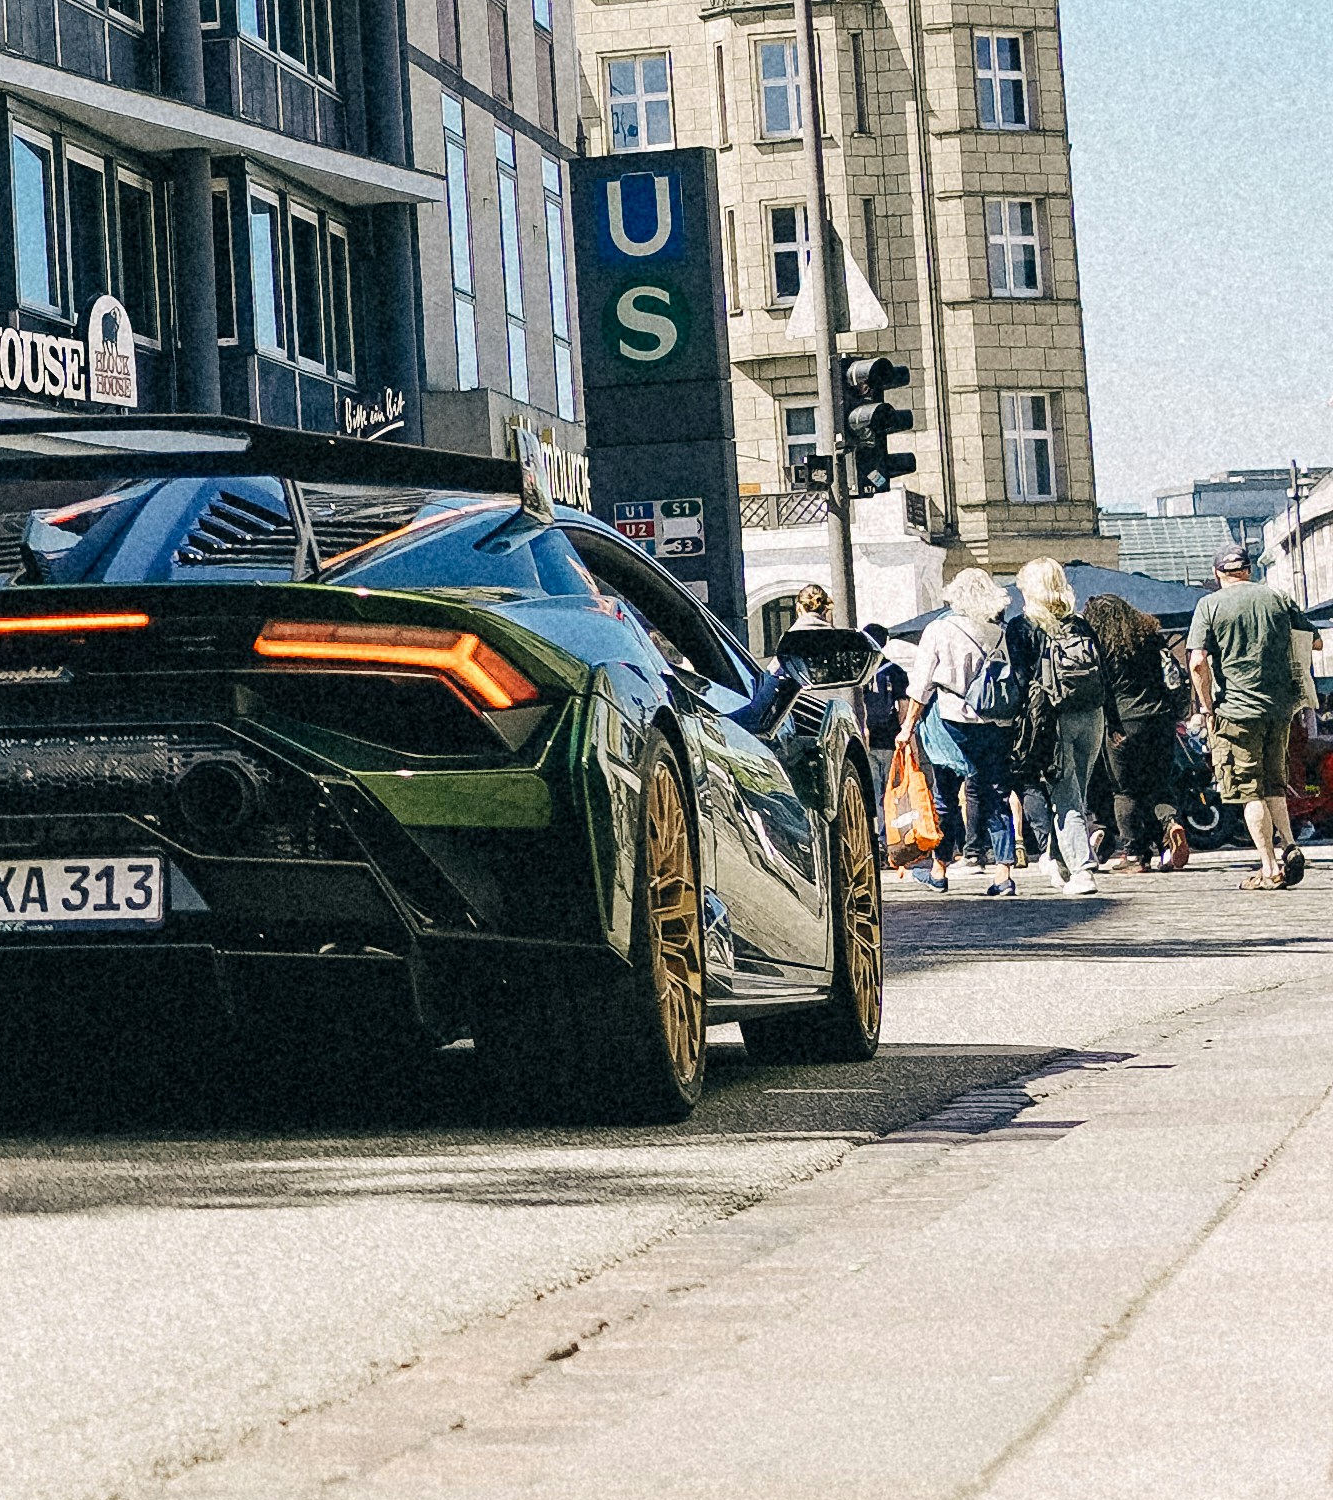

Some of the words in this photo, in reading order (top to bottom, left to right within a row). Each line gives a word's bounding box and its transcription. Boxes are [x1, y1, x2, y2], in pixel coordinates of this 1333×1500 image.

[607, 176, 671, 256] U
[617, 286, 678, 361] S
[94, 350, 130, 376] BLOCK
[96, 373, 132, 398] HOUSE
[625, 506, 644, 518] U1
[673, 503, 690, 515] S1
[626, 525, 647, 536] U2
[61, 865, 154, 912] 313
